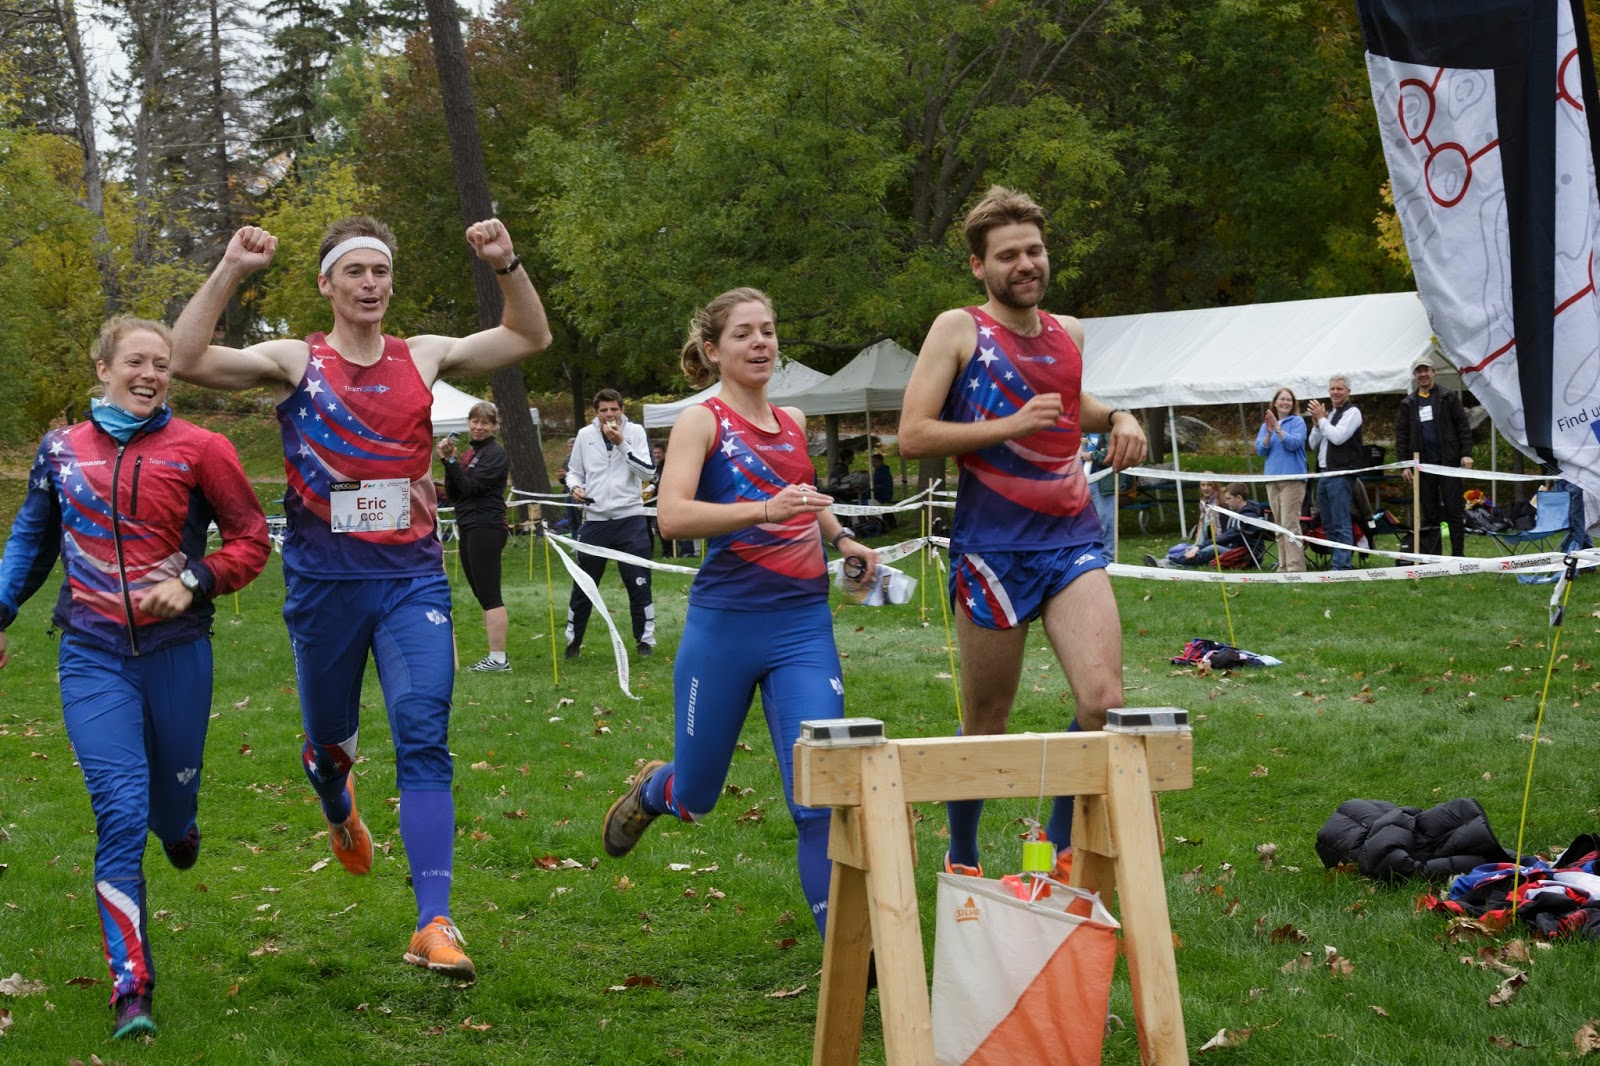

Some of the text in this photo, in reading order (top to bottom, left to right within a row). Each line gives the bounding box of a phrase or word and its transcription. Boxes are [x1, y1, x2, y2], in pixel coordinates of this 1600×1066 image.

[1557, 408, 1589, 432] Find
[357, 497, 387, 510] Eric
[687, 676, 699, 737] noname
[956, 908, 980, 918] SILVA
